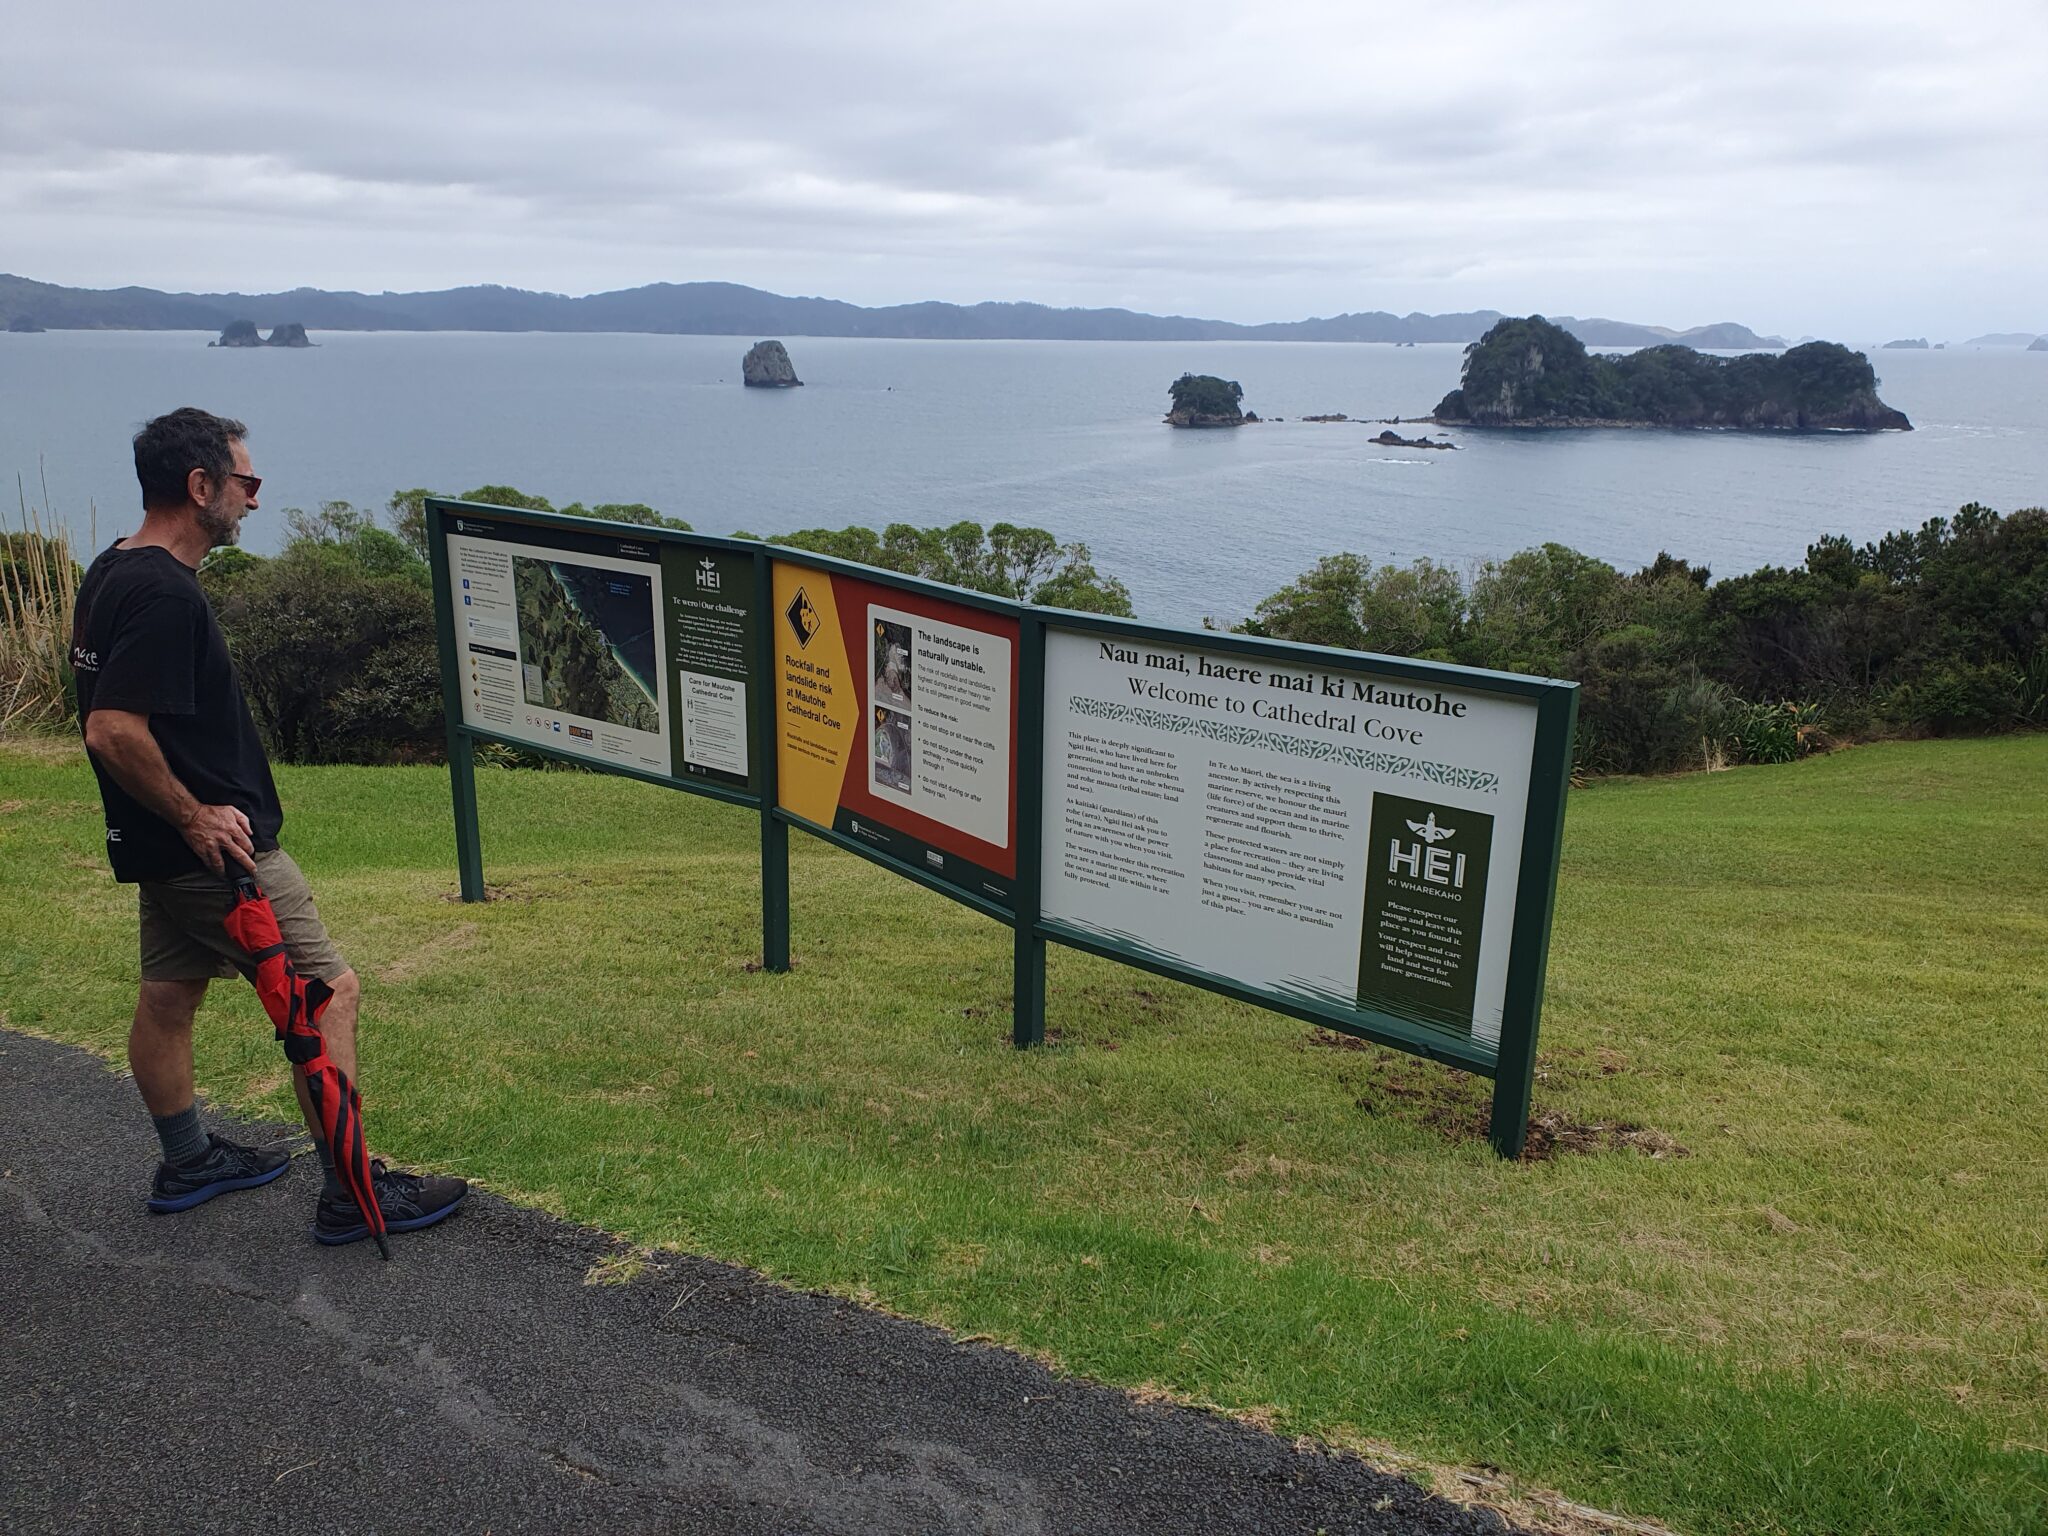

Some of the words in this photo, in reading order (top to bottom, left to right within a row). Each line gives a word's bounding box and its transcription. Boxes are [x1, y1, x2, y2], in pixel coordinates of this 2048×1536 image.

[695, 569, 720, 588] HEI
[672, 596, 681, 605] Te
[681, 599, 699, 608] wero
[700, 601, 715, 610] Our
[714, 603, 747, 617] challenge
[917, 629, 932, 642] The
[932, 633, 971, 653] landscape
[972, 644, 980, 655] is
[785, 654, 815, 673] Rockfall
[815, 666, 830, 679] and
[917, 648, 949, 665] naturally
[950, 657, 986, 674] unstable.
[688, 677, 702, 685] Care
[785, 670, 818, 690] landslide
[818, 683, 833, 696] risk
[1099, 641, 1138, 665] Nau
[1145, 653, 1190, 675] mai,
[1198, 655, 1262, 685] haere
[1268, 673, 1314, 693] mai
[1321, 674, 1345, 699] ki
[1352, 681, 1467, 718] Mautohe
[691, 687, 718, 698] Cathedral
[718, 692, 733, 701] Cove
[786, 687, 794, 698] at
[794, 688, 826, 709] Mautohe
[786, 701, 821, 723] Cathedral
[822, 714, 841, 730] Cove
[1127, 677, 1218, 709] Welcome
[1225, 696, 1245, 714] to
[1252, 699, 1356, 734] Cathedral
[1363, 718, 1423, 746] Cove
[1068, 731, 1082, 739] This
[1083, 734, 1100, 744] place
[1107, 739, 1130, 751] deeply
[1131, 744, 1166, 757] significant
[1067, 753, 1104, 765] generations
[1119, 762, 1135, 772] have
[1145, 770, 1179, 782] unbroken
[1099, 748, 1114, 757] who
[1115, 751, 1131, 760] have
[1131, 754, 1148, 764] lived
[1149, 758, 1165, 768] here
[1166, 761, 1177, 770] for
[1208, 759, 1217, 768] In
[1218, 761, 1227, 770] Te
[1229, 764, 1239, 772] Ao
[1265, 771, 1278, 780] the
[1279, 775, 1292, 783] sea
[1293, 777, 1300, 785] is
[1308, 779, 1331, 793] living
[1207, 783, 1234, 793] marine
[1278, 796, 1307, 809] honour
[1308, 803, 1322, 812] the
[1323, 808, 1347, 818] mauri
[1242, 777, 1251, 787] By
[1253, 781, 1281, 792] actively
[1283, 788, 1324, 803] respecting
[1325, 795, 1341, 805] this
[1205, 815, 1244, 828] regenerate
[1244, 824, 1259, 832] and
[1206, 792, 1222, 801] (life
[1223, 795, 1245, 807] force)
[1255, 803, 1268, 812] the
[1269, 807, 1292, 817] ocean
[1293, 812, 1308, 821] and
[1321, 818, 1350, 830] marine
[1206, 804, 1239, 816] creatures
[1240, 812, 1255, 820] and
[1256, 815, 1286, 827] support
[1287, 821, 1307, 832] them
[1308, 826, 1317, 834] to
[1205, 830, 1226, 840] These
[1227, 836, 1262, 849] protected
[1262, 844, 1288, 855] waters
[1289, 851, 1302, 859] are
[1303, 854, 1317, 862] not
[1318, 857, 1344, 870] simply
[1210, 842, 1229, 852] place
[1230, 846, 1242, 855] for
[1243, 851, 1281, 865] recreation
[1288, 861, 1305, 872] they
[1321, 868, 1344, 882] living
[1203, 851, 1244, 867] classrooms
[1244, 862, 1259, 870] and
[1260, 865, 1276, 874] also
[1276, 870, 1306, 882] provide
[1307, 878, 1325, 887] vital
[1203, 860, 1231, 874] habitats
[1232, 868, 1244, 877] for
[1245, 873, 1265, 884] many
[1388, 838, 1466, 889] HEI
[1387, 877, 1397, 887] KI
[1399, 880, 1462, 902] WHAREKAHO
[1381, 910, 1407, 922] taonga
[1408, 917, 1424, 926] and
[1424, 920, 1446, 931] leave
[1446, 926, 1463, 936] this
[1387, 901, 1412, 913] Please
[1413, 908, 1442, 920] respect
[1442, 916, 1458, 924] our
[1379, 920, 1401, 930] place
[1411, 928, 1427, 937] you
[1428, 931, 1452, 943] found
[1377, 931, 1397, 942] Your
[1398, 938, 1427, 950] respect
[1427, 946, 1443, 955] and
[1444, 950, 1462, 960] care
[1378, 943, 1394, 952] will
[1394, 946, 1413, 958] help
[1413, 952, 1442, 965] sustain
[1443, 959, 1459, 969] this
[1380, 962, 1404, 975] future
[1386, 953, 1404, 965] land
[1405, 960, 1421, 969] and
[1421, 965, 1435, 973] sea
[1436, 967, 1449, 977] for
